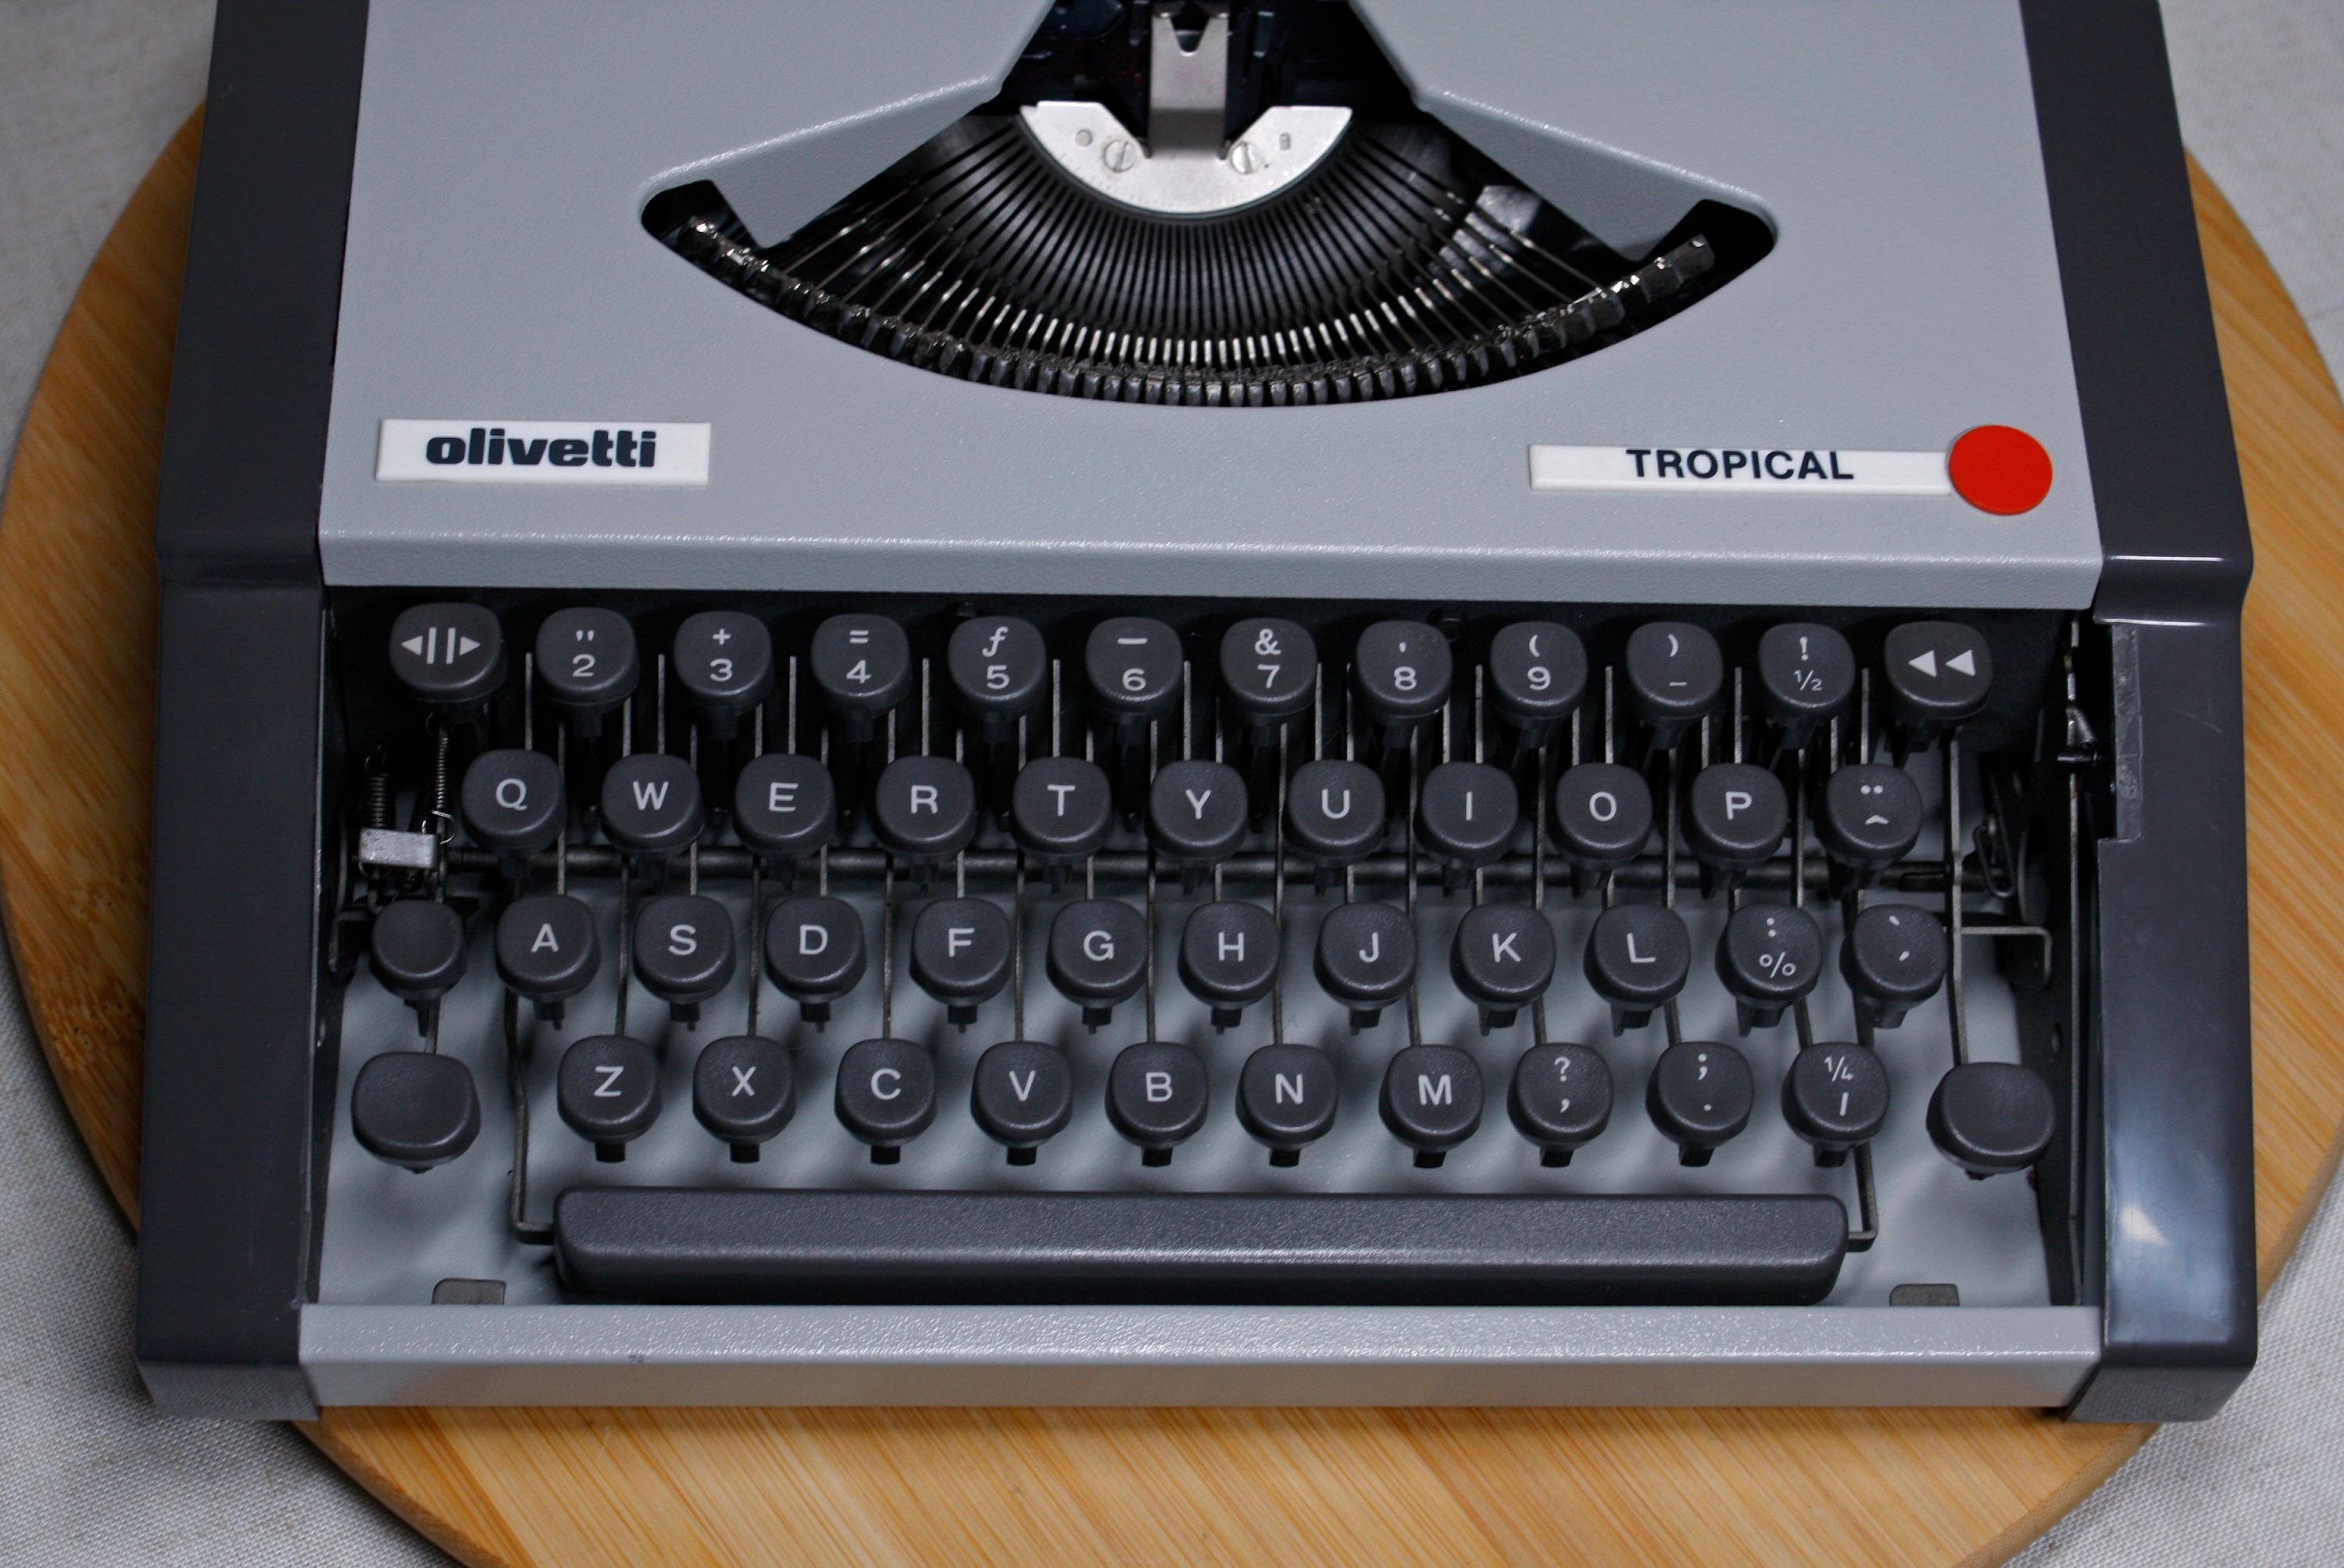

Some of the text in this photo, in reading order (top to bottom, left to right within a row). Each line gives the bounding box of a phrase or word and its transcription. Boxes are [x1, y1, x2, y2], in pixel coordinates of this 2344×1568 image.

[425, 427, 657, 468] olivetti
[1626, 448, 1855, 480] TROPICAL
[849, 630, 869, 644] =
[1254, 628, 1281, 655] &
[1528, 634, 1540, 657] (
[1668, 634, 1679, 657] )
[1799, 636, 1809, 661] !
[573, 654, 595, 677] 2
[710, 659, 733, 682] 3
[846, 659, 871, 684] 4
[987, 665, 1009, 690] 5
[1122, 668, 1146, 692] 6
[1257, 664, 1280, 688] 7
[1393, 666, 1417, 691] 8
[1527, 666, 1551, 691] 9
[496, 778, 527, 811] Q
[632, 780, 670, 811] W
[769, 782, 799, 813] E
[910, 784, 939, 814] R
[1046, 784, 1077, 816] T
[1185, 789, 1212, 820] Y
[1321, 788, 1351, 819] U
[1588, 791, 1617, 822] O
[1724, 791, 1753, 821] P
[531, 923, 560, 953] A
[668, 924, 697, 956] S
[799, 924, 828, 955] D
[948, 927, 975, 958] F
[1083, 929, 1114, 962] G
[1217, 930, 1245, 963] H
[1358, 931, 1380, 963] J
[1492, 932, 1522, 963] K
[1626, 932, 1656, 964] L
[1758, 951, 1796, 979] %
[593, 1065, 624, 1098] Z
[731, 1066, 756, 1097] X
[870, 1067, 902, 1101] C
[1553, 1055, 1571, 1083] ?
[1008, 1070, 1036, 1102] V
[1145, 1071, 1174, 1102] B
[1274, 1073, 1304, 1105] N
[1417, 1073, 1453, 1106] M
